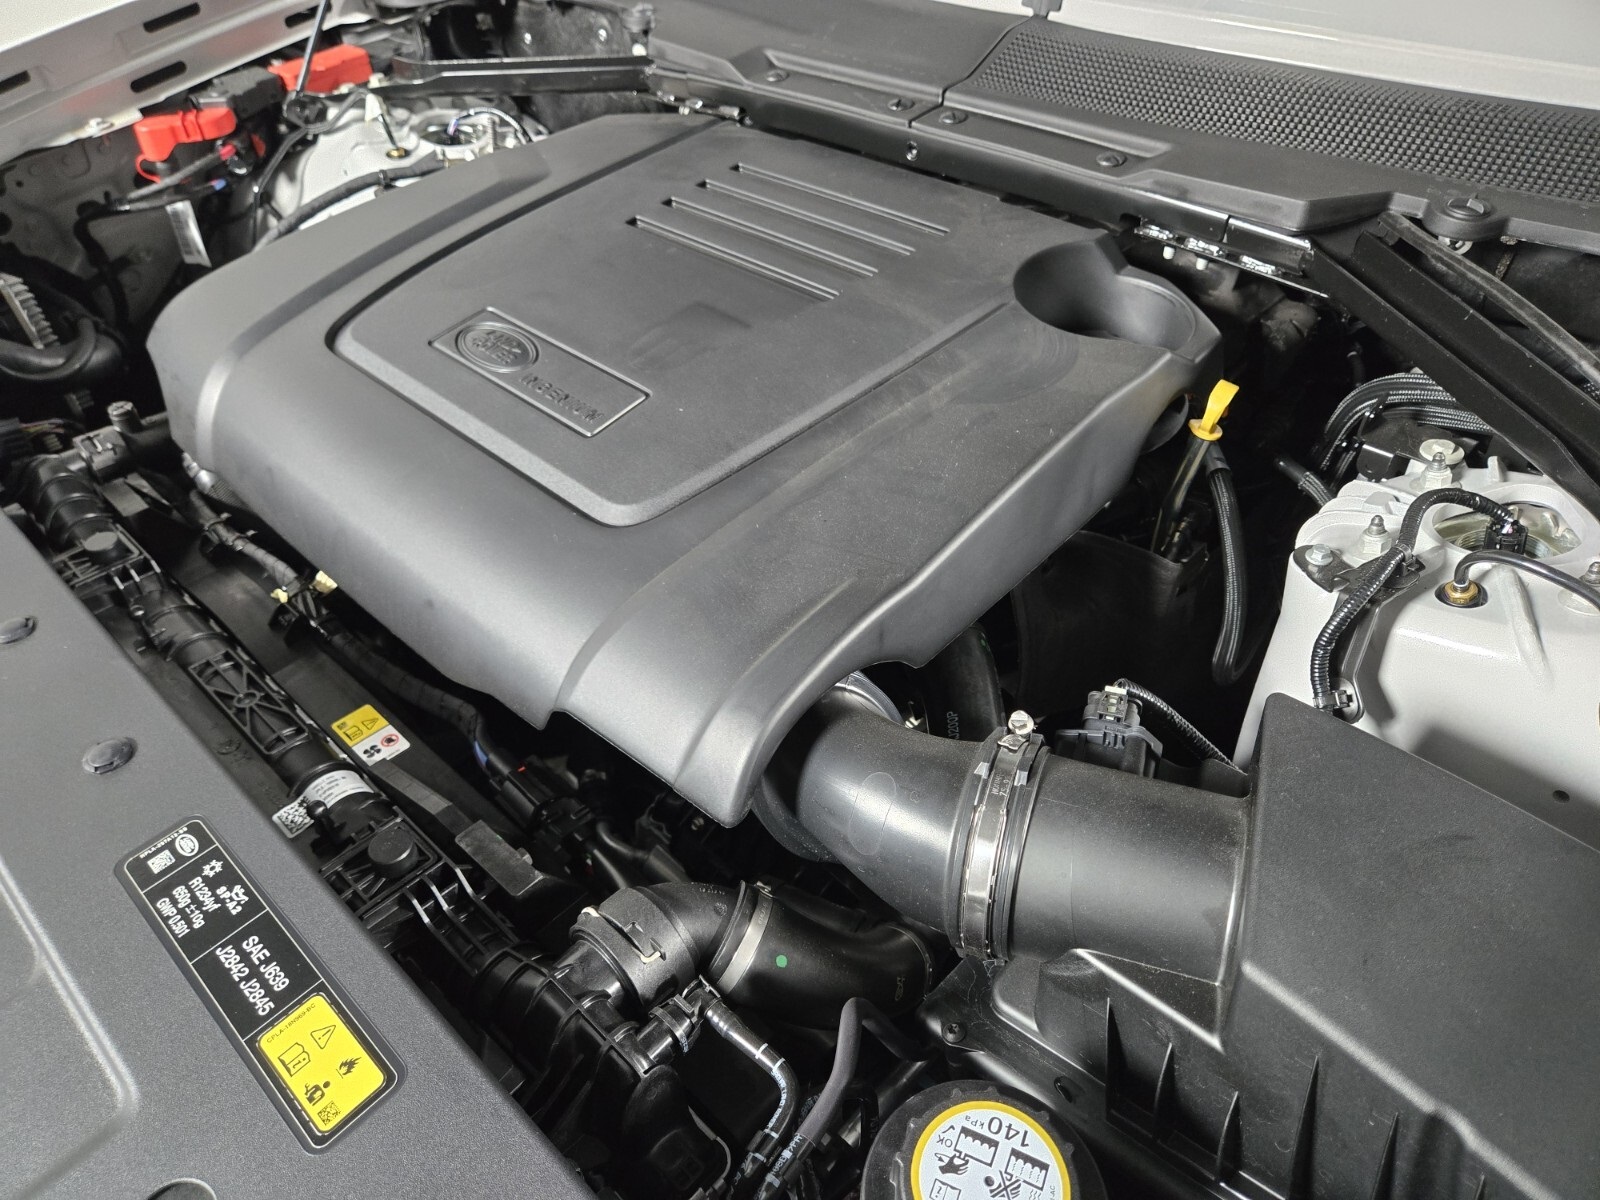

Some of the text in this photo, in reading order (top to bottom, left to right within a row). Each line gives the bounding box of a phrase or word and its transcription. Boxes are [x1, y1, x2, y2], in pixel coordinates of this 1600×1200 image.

[172, 885, 205, 929] 650g ±10g
[188, 876, 221, 912] R1234yf
[156, 897, 190, 938] GWP 0.501
[215, 945, 275, 1016] J2842 J2845
[242, 935, 290, 992] SAE J639
[936, 1134, 953, 1148] OK
[988, 1116, 1030, 1148] 140
